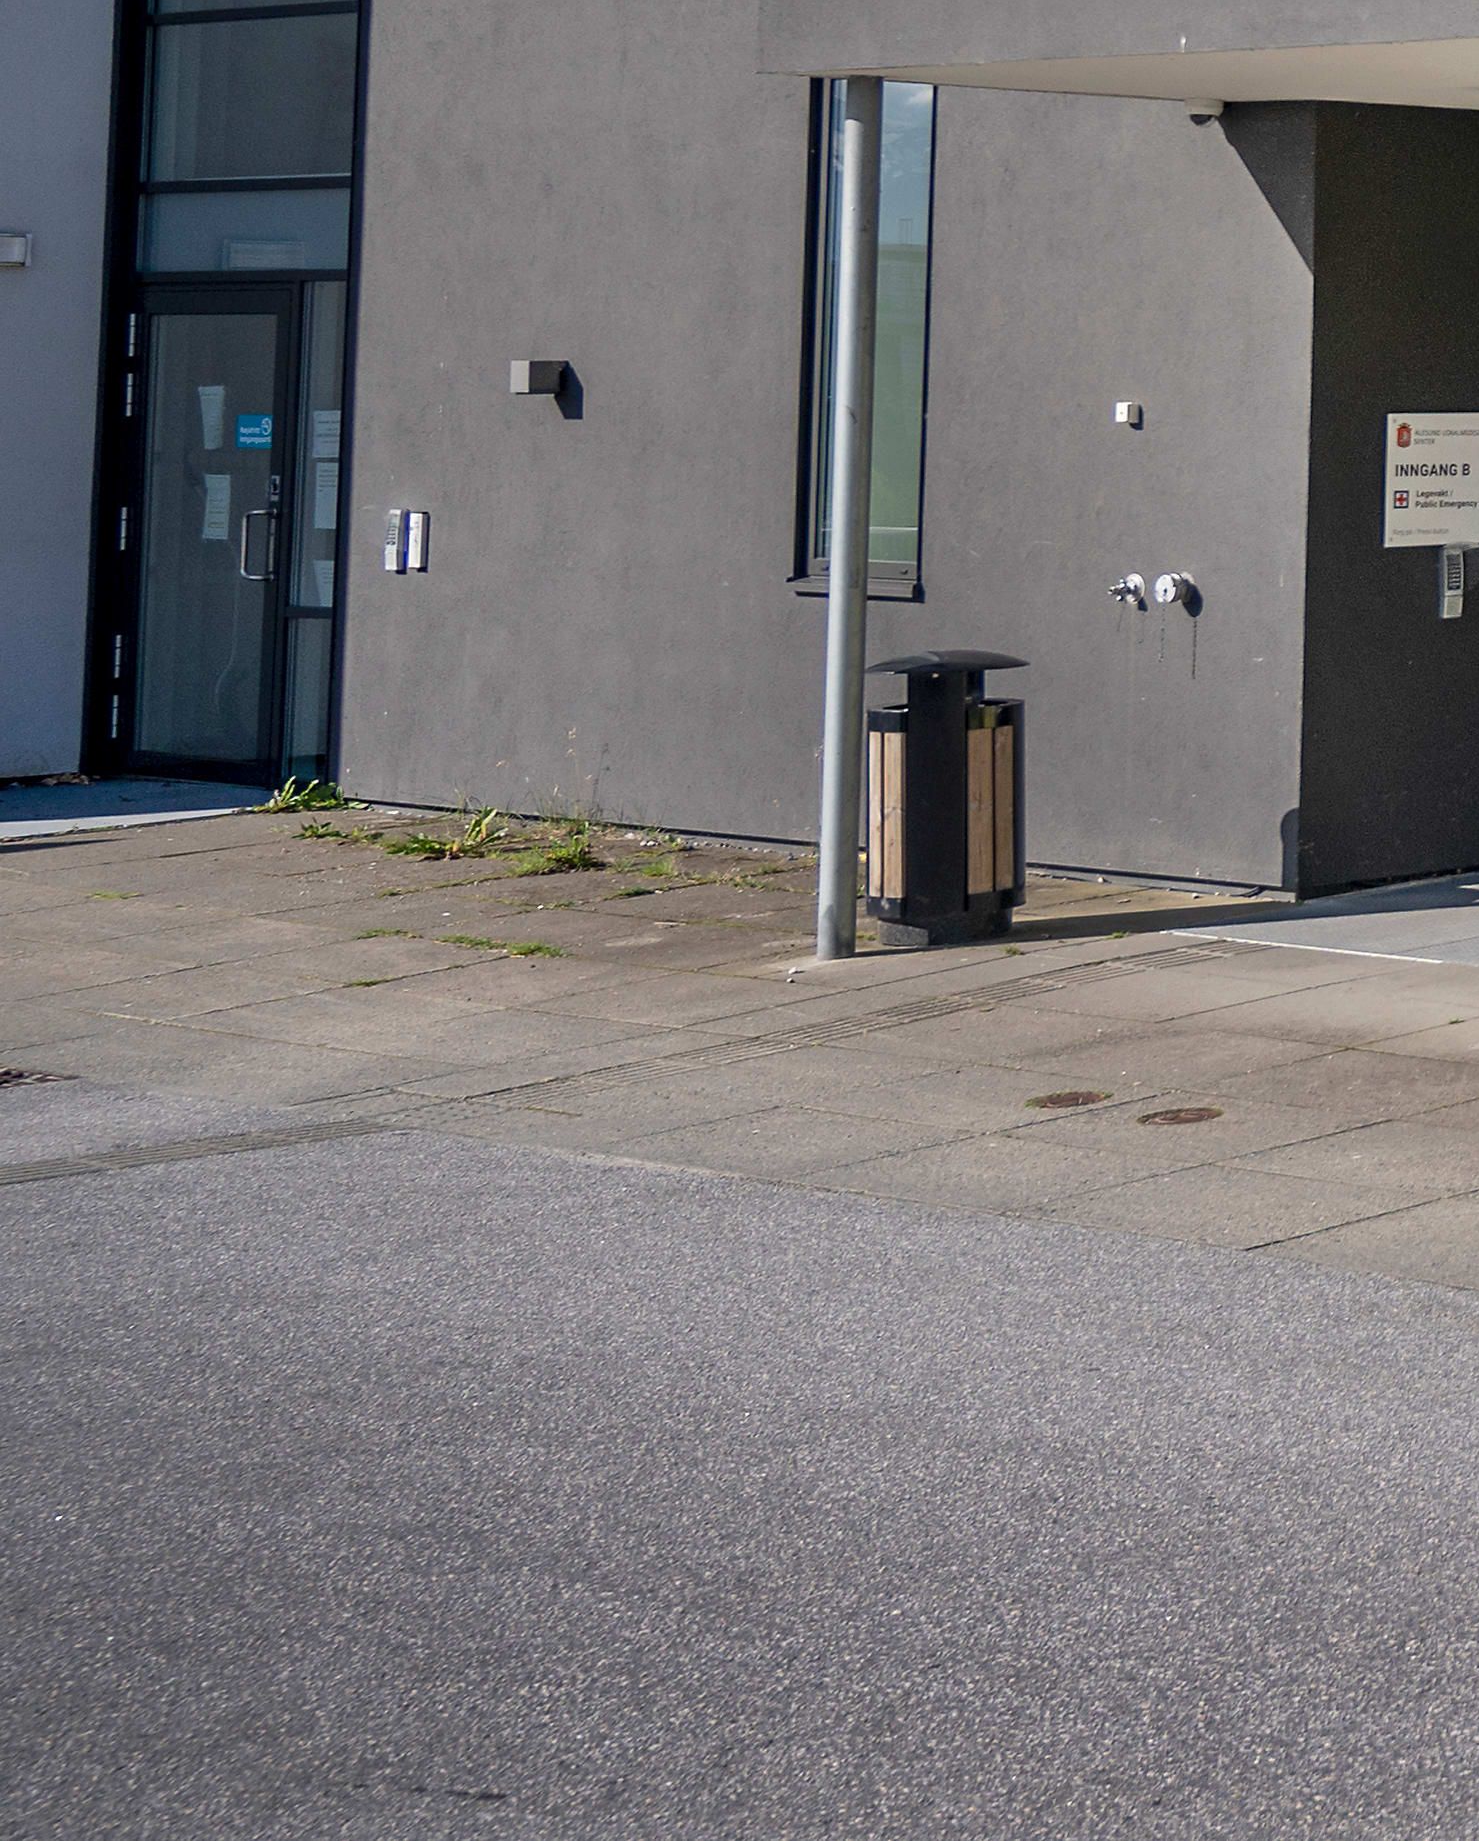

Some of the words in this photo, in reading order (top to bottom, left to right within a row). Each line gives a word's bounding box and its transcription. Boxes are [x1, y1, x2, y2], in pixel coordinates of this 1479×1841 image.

[1395, 463, 1458, 477] INNGANG
[1462, 463, 1471, 476] B
[1416, 490, 1448, 499] Legevakt
[1415, 500, 1438, 508] Public
[1440, 500, 1477, 509] Emergency
